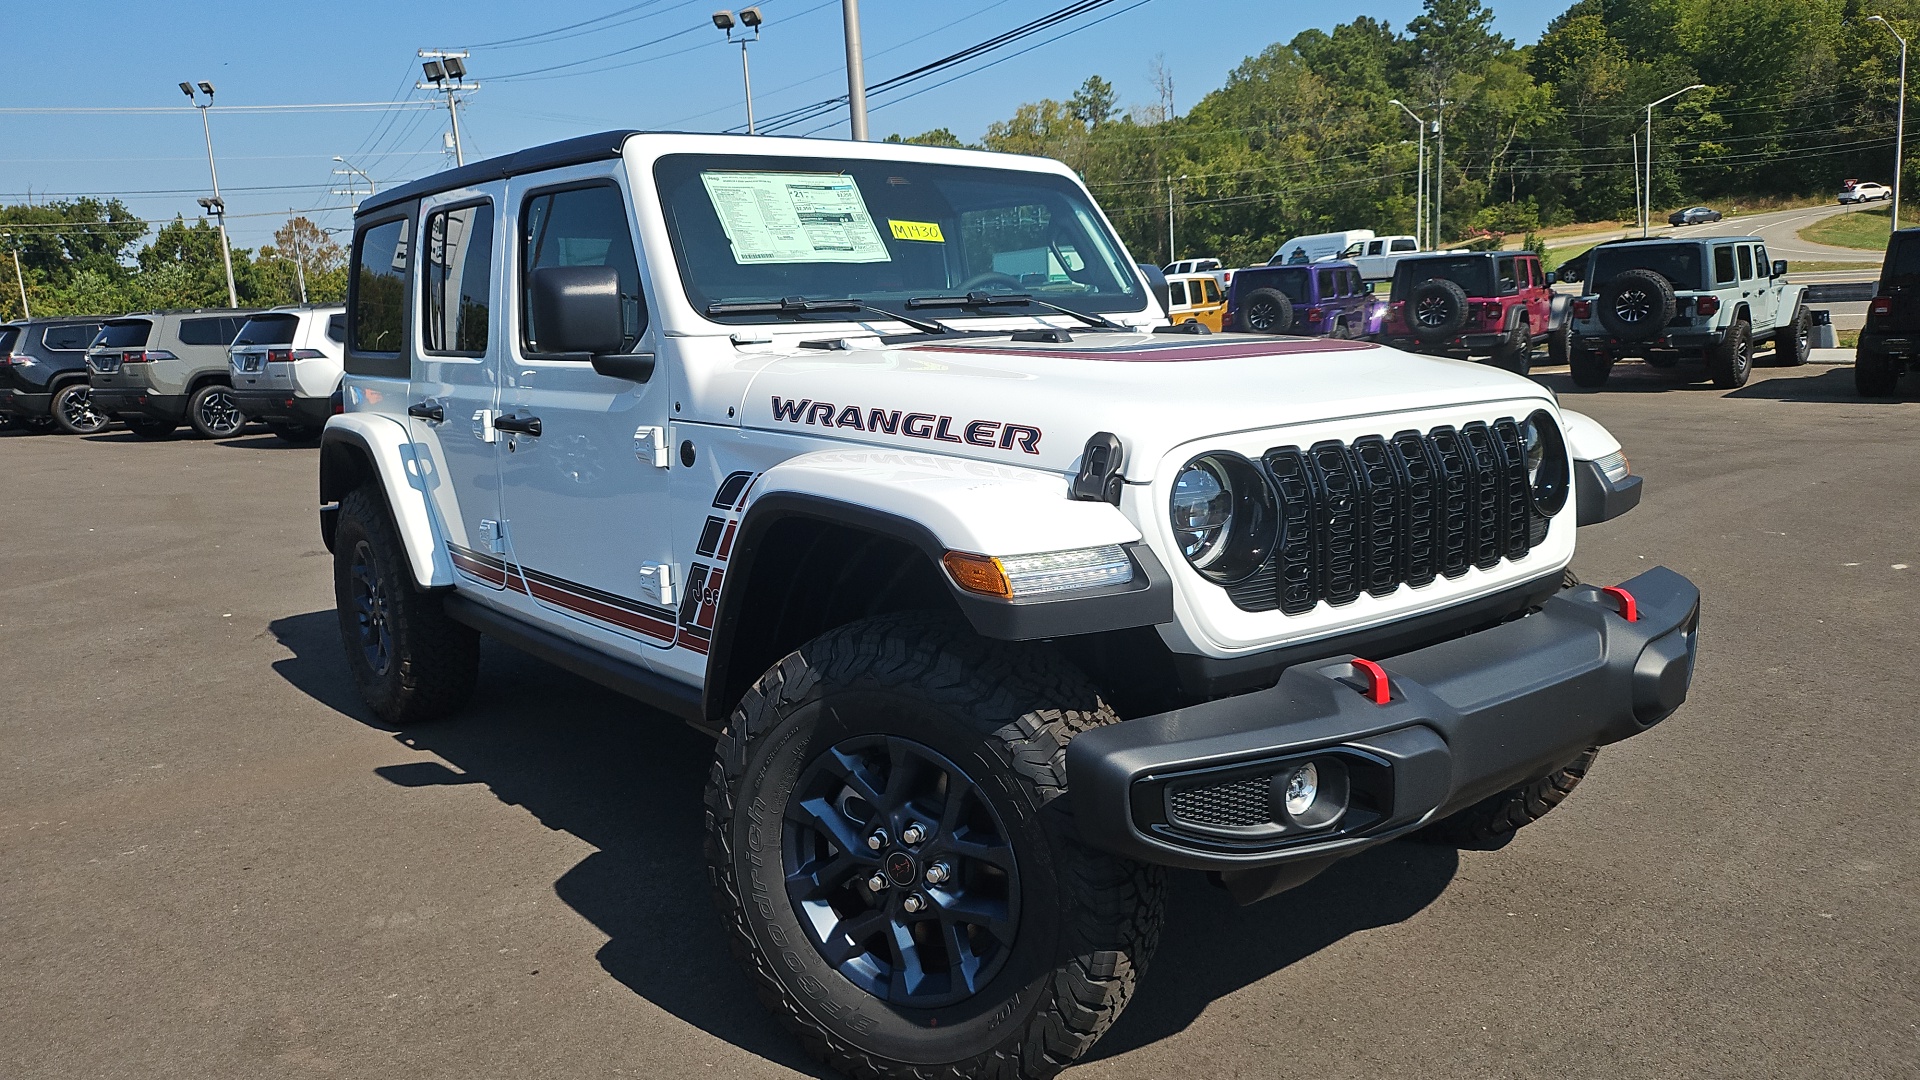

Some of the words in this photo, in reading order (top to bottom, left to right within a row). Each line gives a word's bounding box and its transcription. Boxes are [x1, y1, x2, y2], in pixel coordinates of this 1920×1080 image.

[893, 223, 939, 239] M1430
[771, 395, 1043, 455] WRANGLER
[692, 579, 720, 607] Jee
[746, 796, 880, 1037] BFGoodrich
